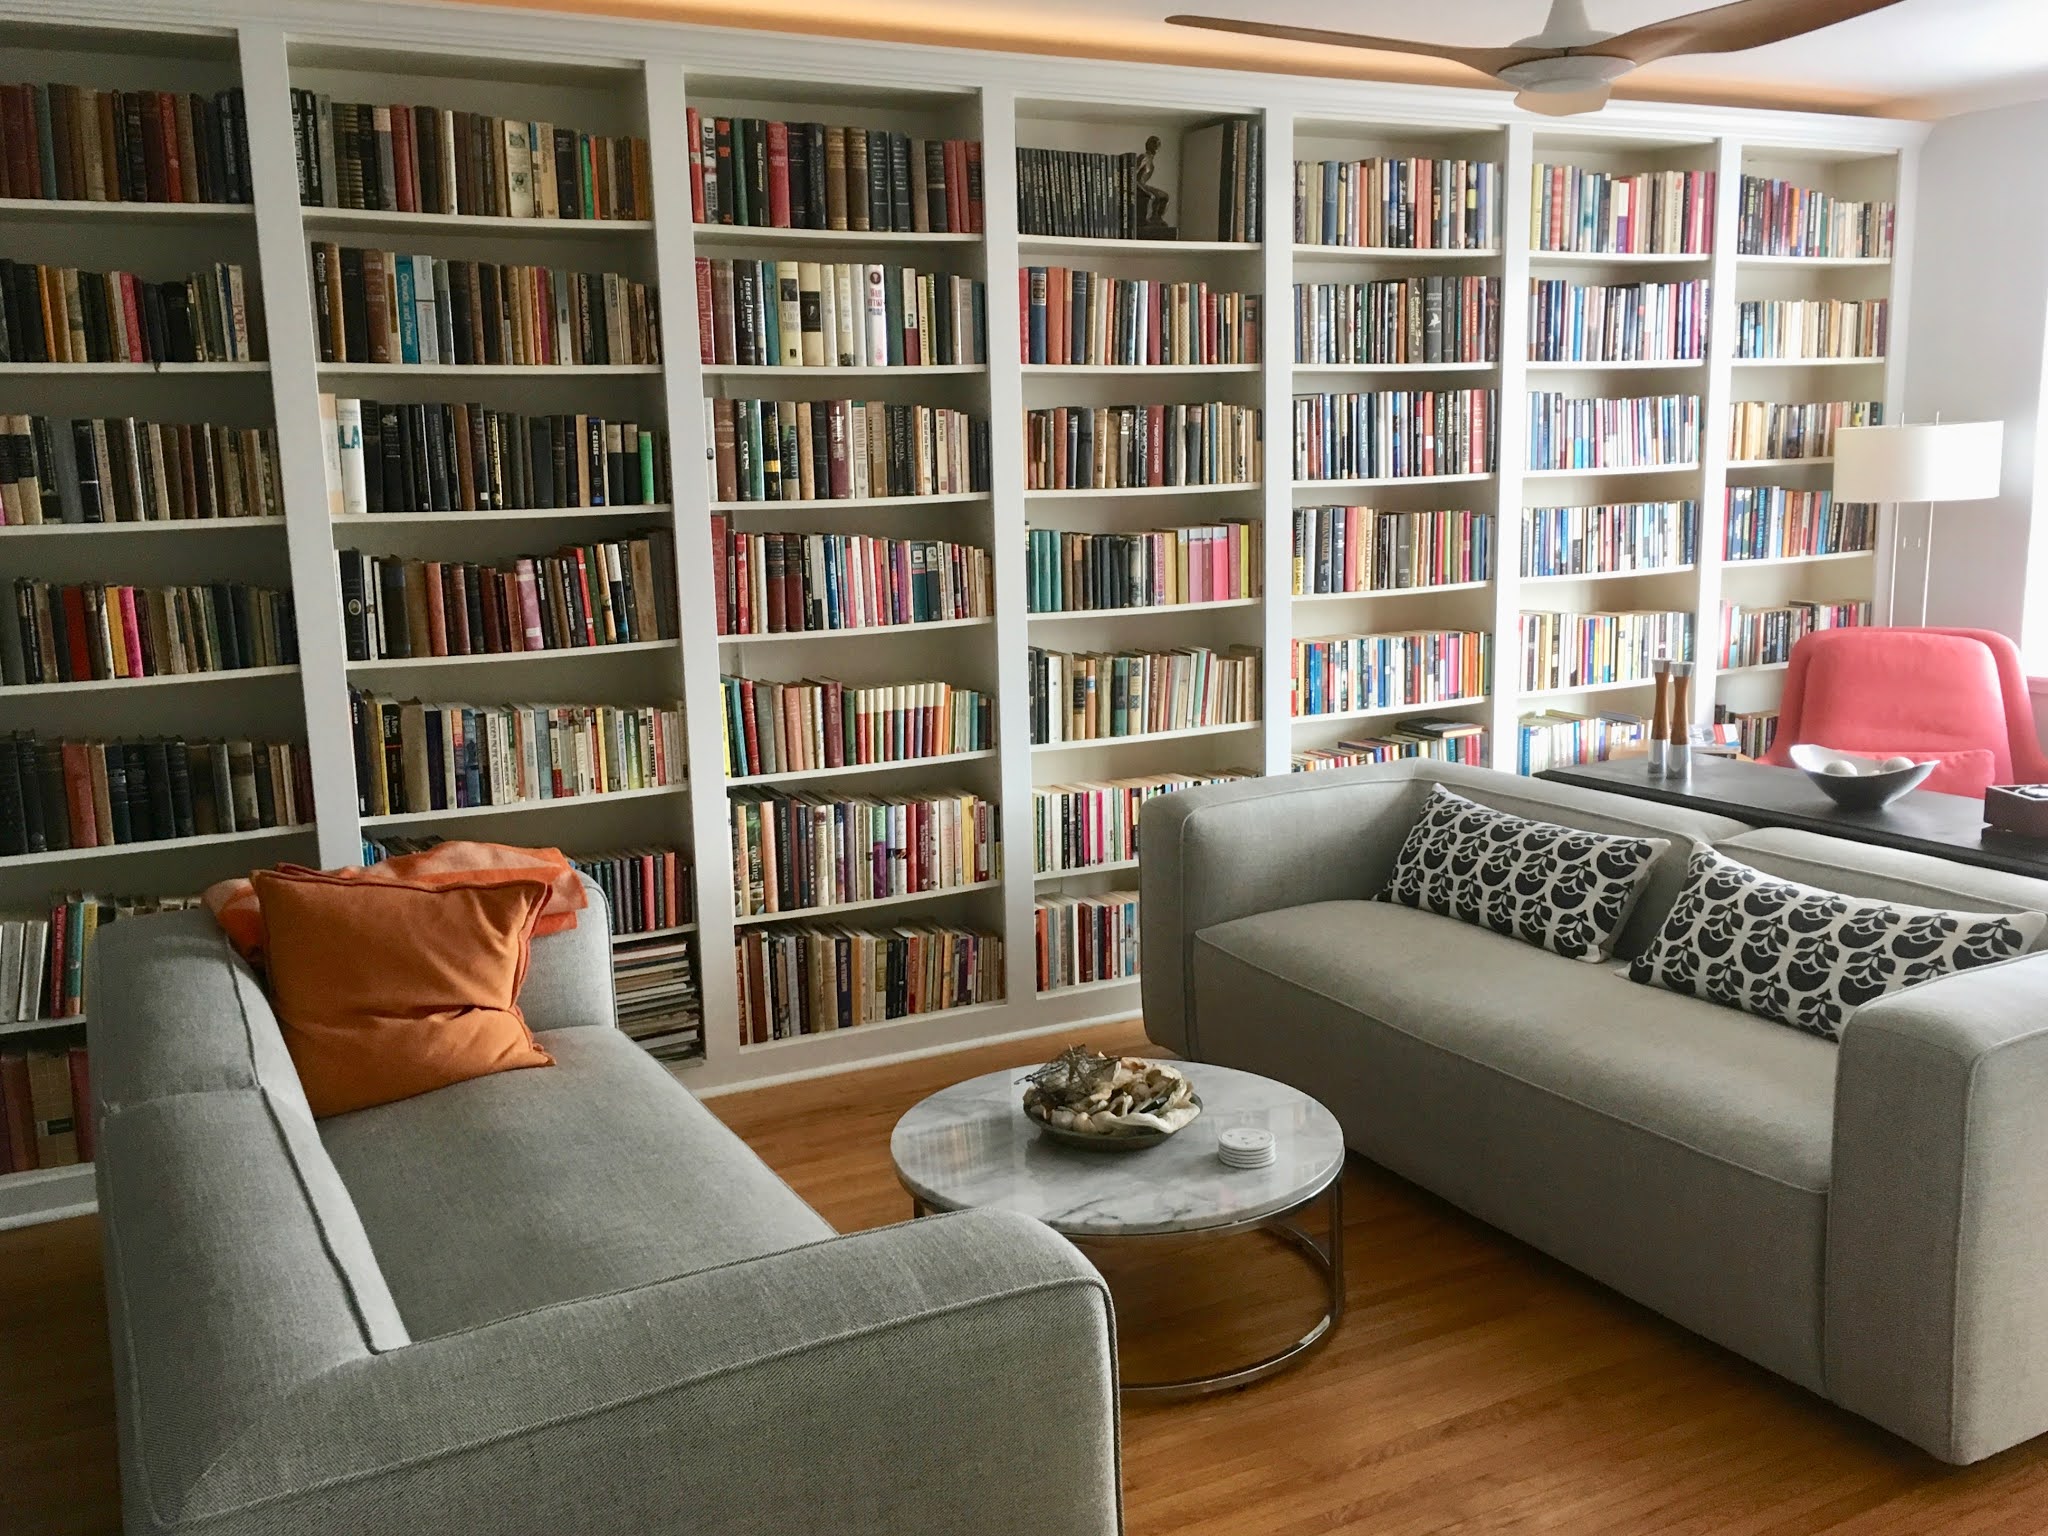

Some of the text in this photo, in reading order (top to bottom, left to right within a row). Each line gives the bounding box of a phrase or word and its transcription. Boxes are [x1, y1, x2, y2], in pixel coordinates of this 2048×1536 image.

[292, 113, 302, 128] The
[704, 126, 714, 159] D-DAY
[316, 252, 326, 284] Origins
[400, 272, 413, 346] Crowds and Power
[697, 267, 712, 353] Southern Daughter
[742, 276, 754, 333] Jesse James
[338, 425, 361, 449] LA
[855, 409, 866, 460] MUHAMMAD ALI
[1140, 410, 1148, 459] NABOKOV
[1322, 511, 1330, 538] NORMAN
[490, 740, 498, 759] PACIFIC
[750, 845, 760, 880] cooking
